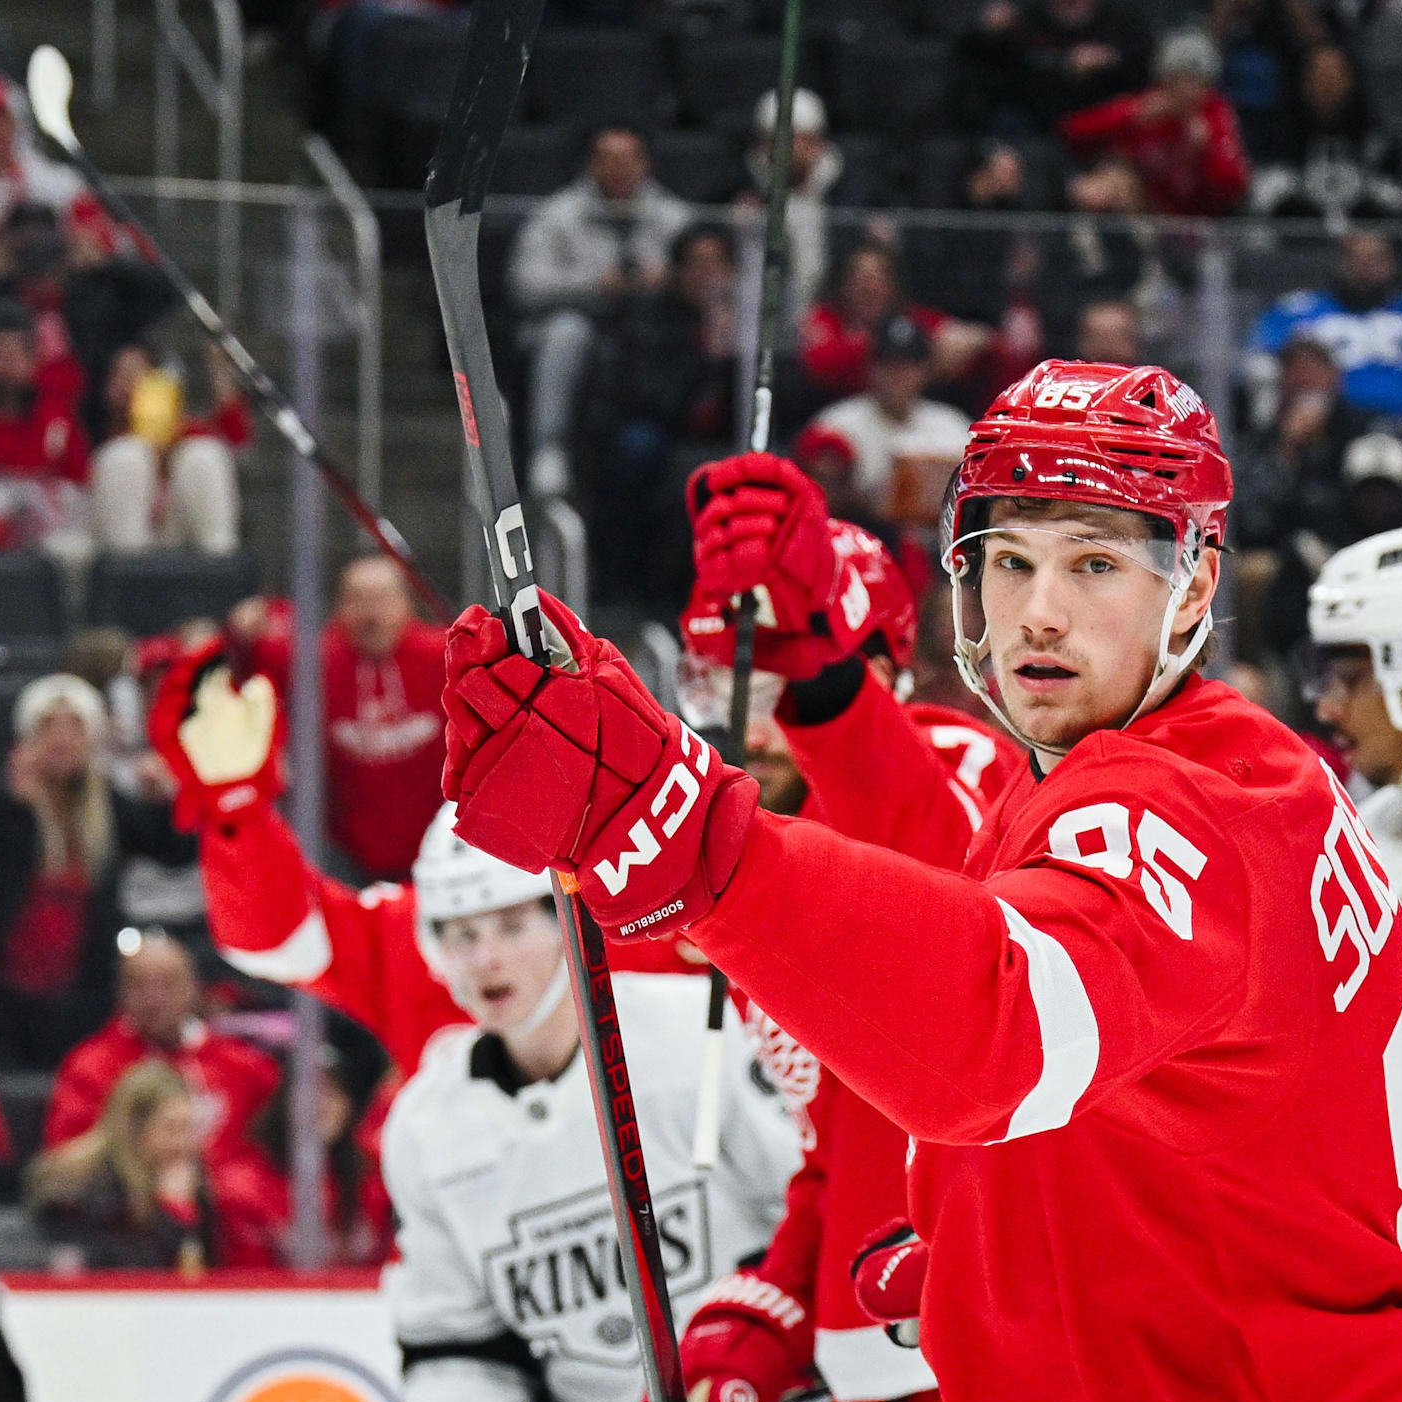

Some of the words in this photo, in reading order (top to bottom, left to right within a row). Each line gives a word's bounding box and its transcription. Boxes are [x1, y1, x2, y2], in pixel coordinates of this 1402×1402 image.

[1035, 384, 1099, 410] 85
[495, 503, 549, 658] CC
[592, 719, 711, 896] CCM
[1045, 802, 1208, 941] 85
[619, 899, 685, 937] SODERBLOM
[585, 947, 645, 1182] JETSPEED
[506, 1202, 693, 1323] KINS
